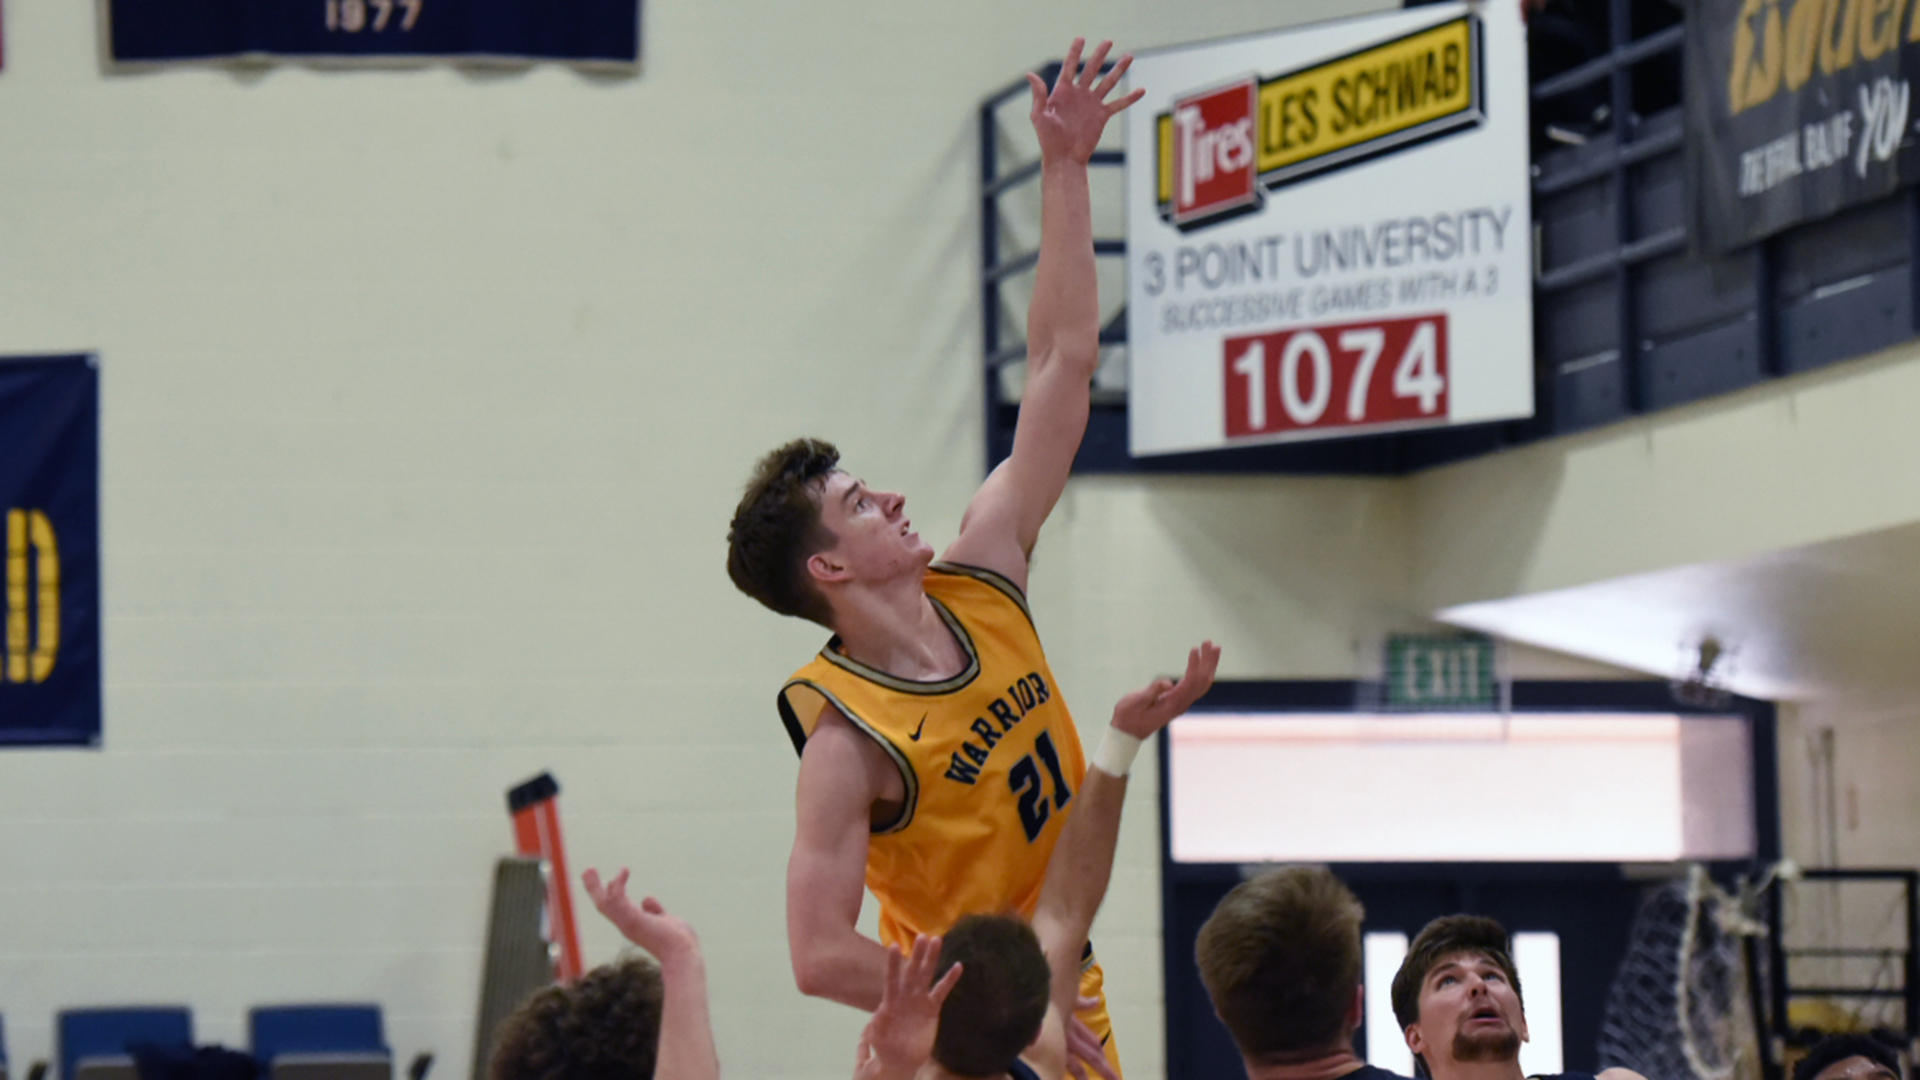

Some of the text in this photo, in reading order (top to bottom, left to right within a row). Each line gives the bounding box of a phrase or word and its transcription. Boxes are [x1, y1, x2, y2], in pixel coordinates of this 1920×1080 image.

[1262, 41, 1461, 155] LES SCHWAB
[1175, 104, 1253, 207] Tires
[1143, 206, 1512, 297] 3 POINT UNIVERSITY
[1160, 264, 1500, 334] SUCCESSIVE GAMES WITH A 3
[1232, 320, 1445, 431] 1074
[0, 508, 60, 683] D
[1404, 645, 1479, 700] EXIT
[943, 671, 1050, 786] WARRIOR
[1008, 728, 1073, 844] 21
